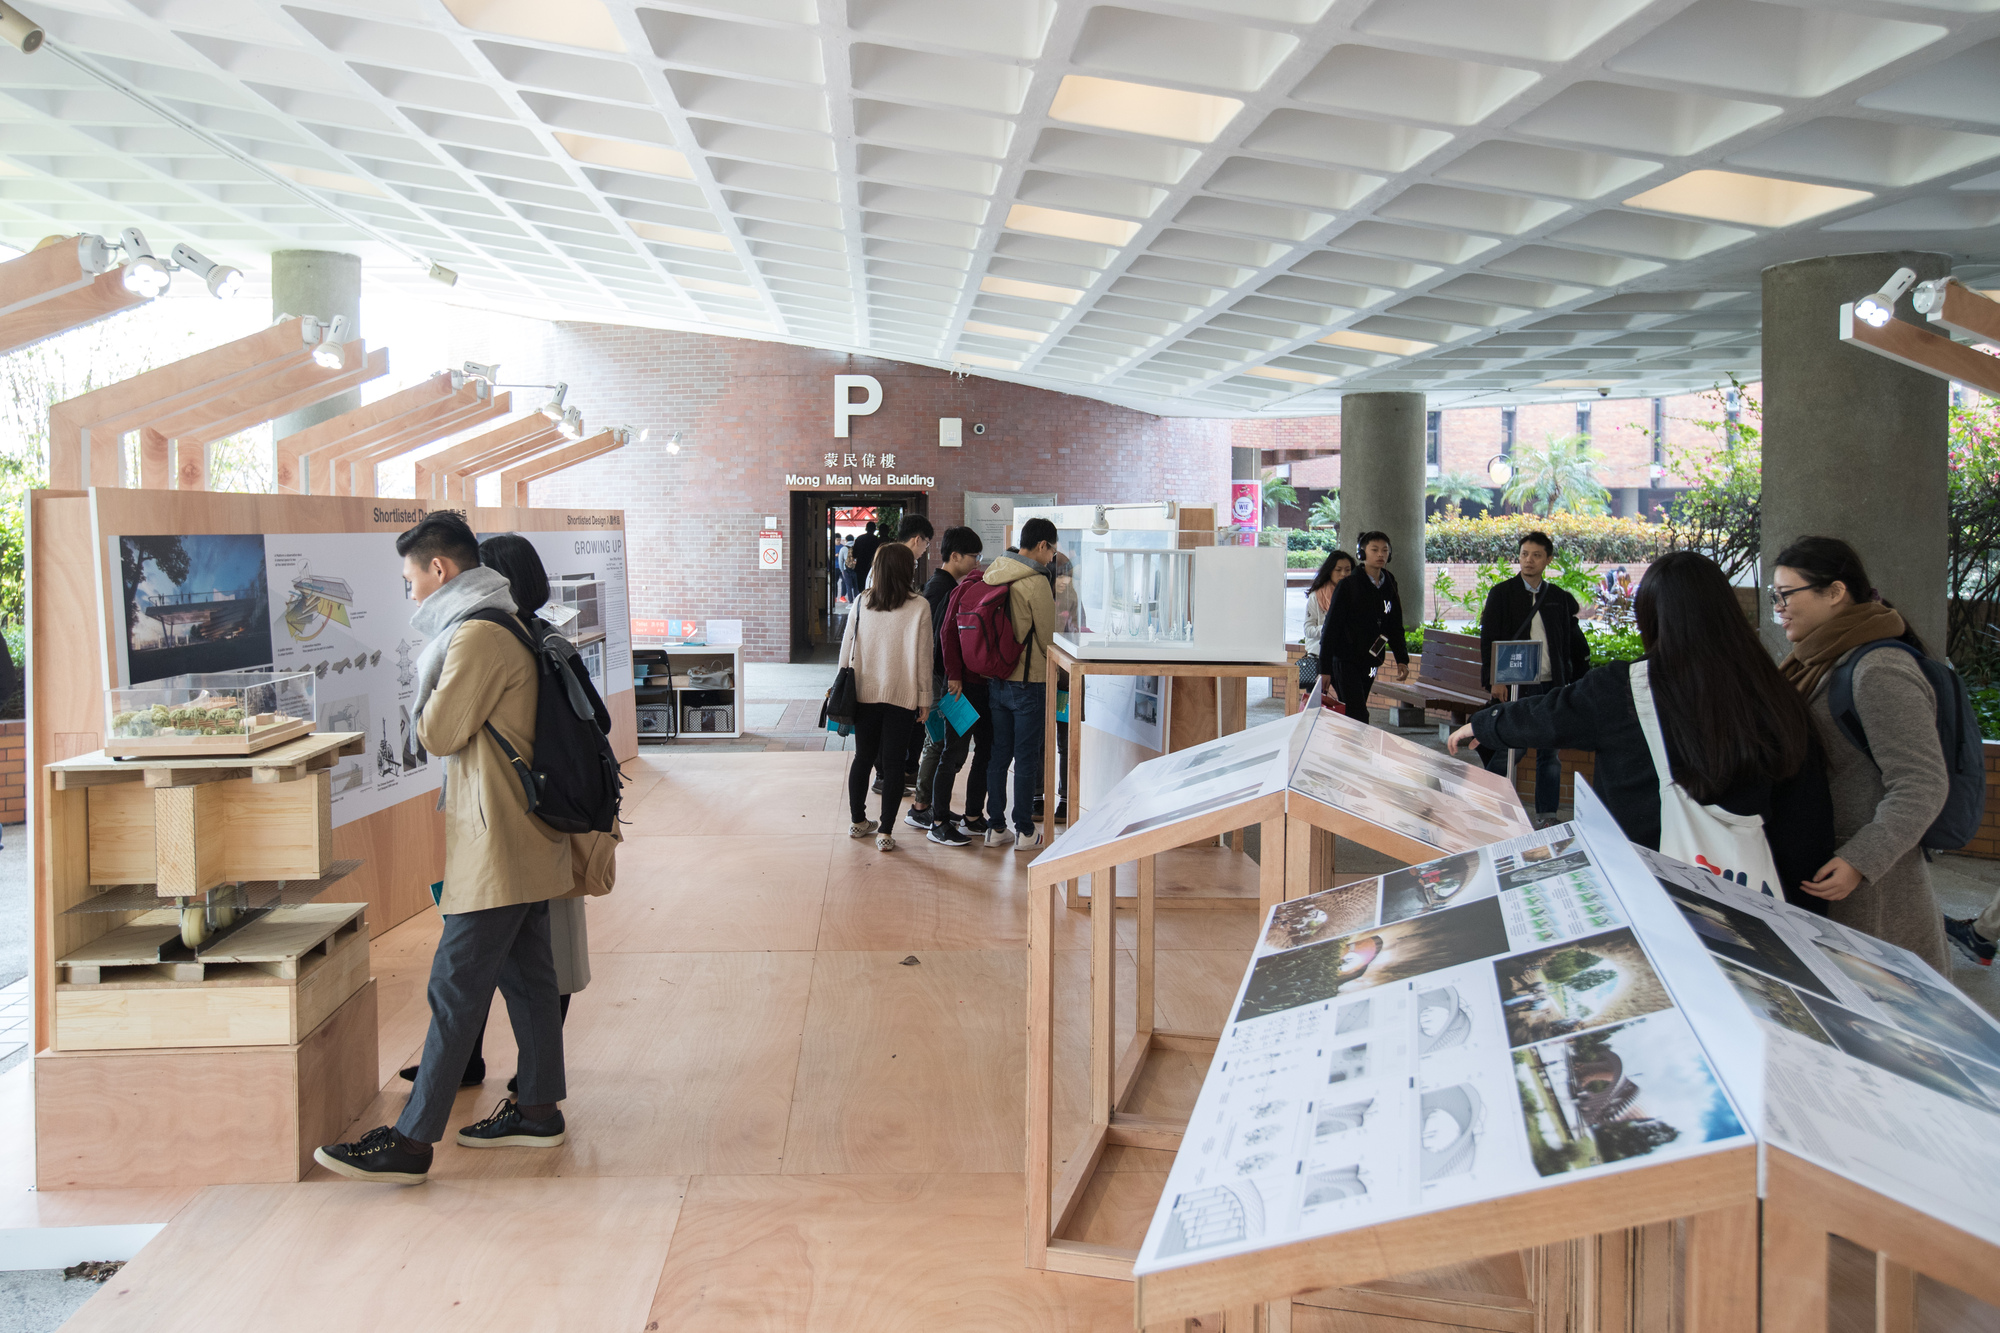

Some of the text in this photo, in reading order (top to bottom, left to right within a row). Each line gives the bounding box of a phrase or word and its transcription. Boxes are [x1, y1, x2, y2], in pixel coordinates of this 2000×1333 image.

[834, 374, 883, 438] P
[824, 452, 896, 469] 蒙民偉樓
[785, 474, 935, 487] Mong Man Wai Building
[373, 507, 417, 523] Shortlisted
[567, 515, 591, 525] Shortlisted
[592, 516, 606, 527] Design
[574, 540, 622, 555] GROWING UP
